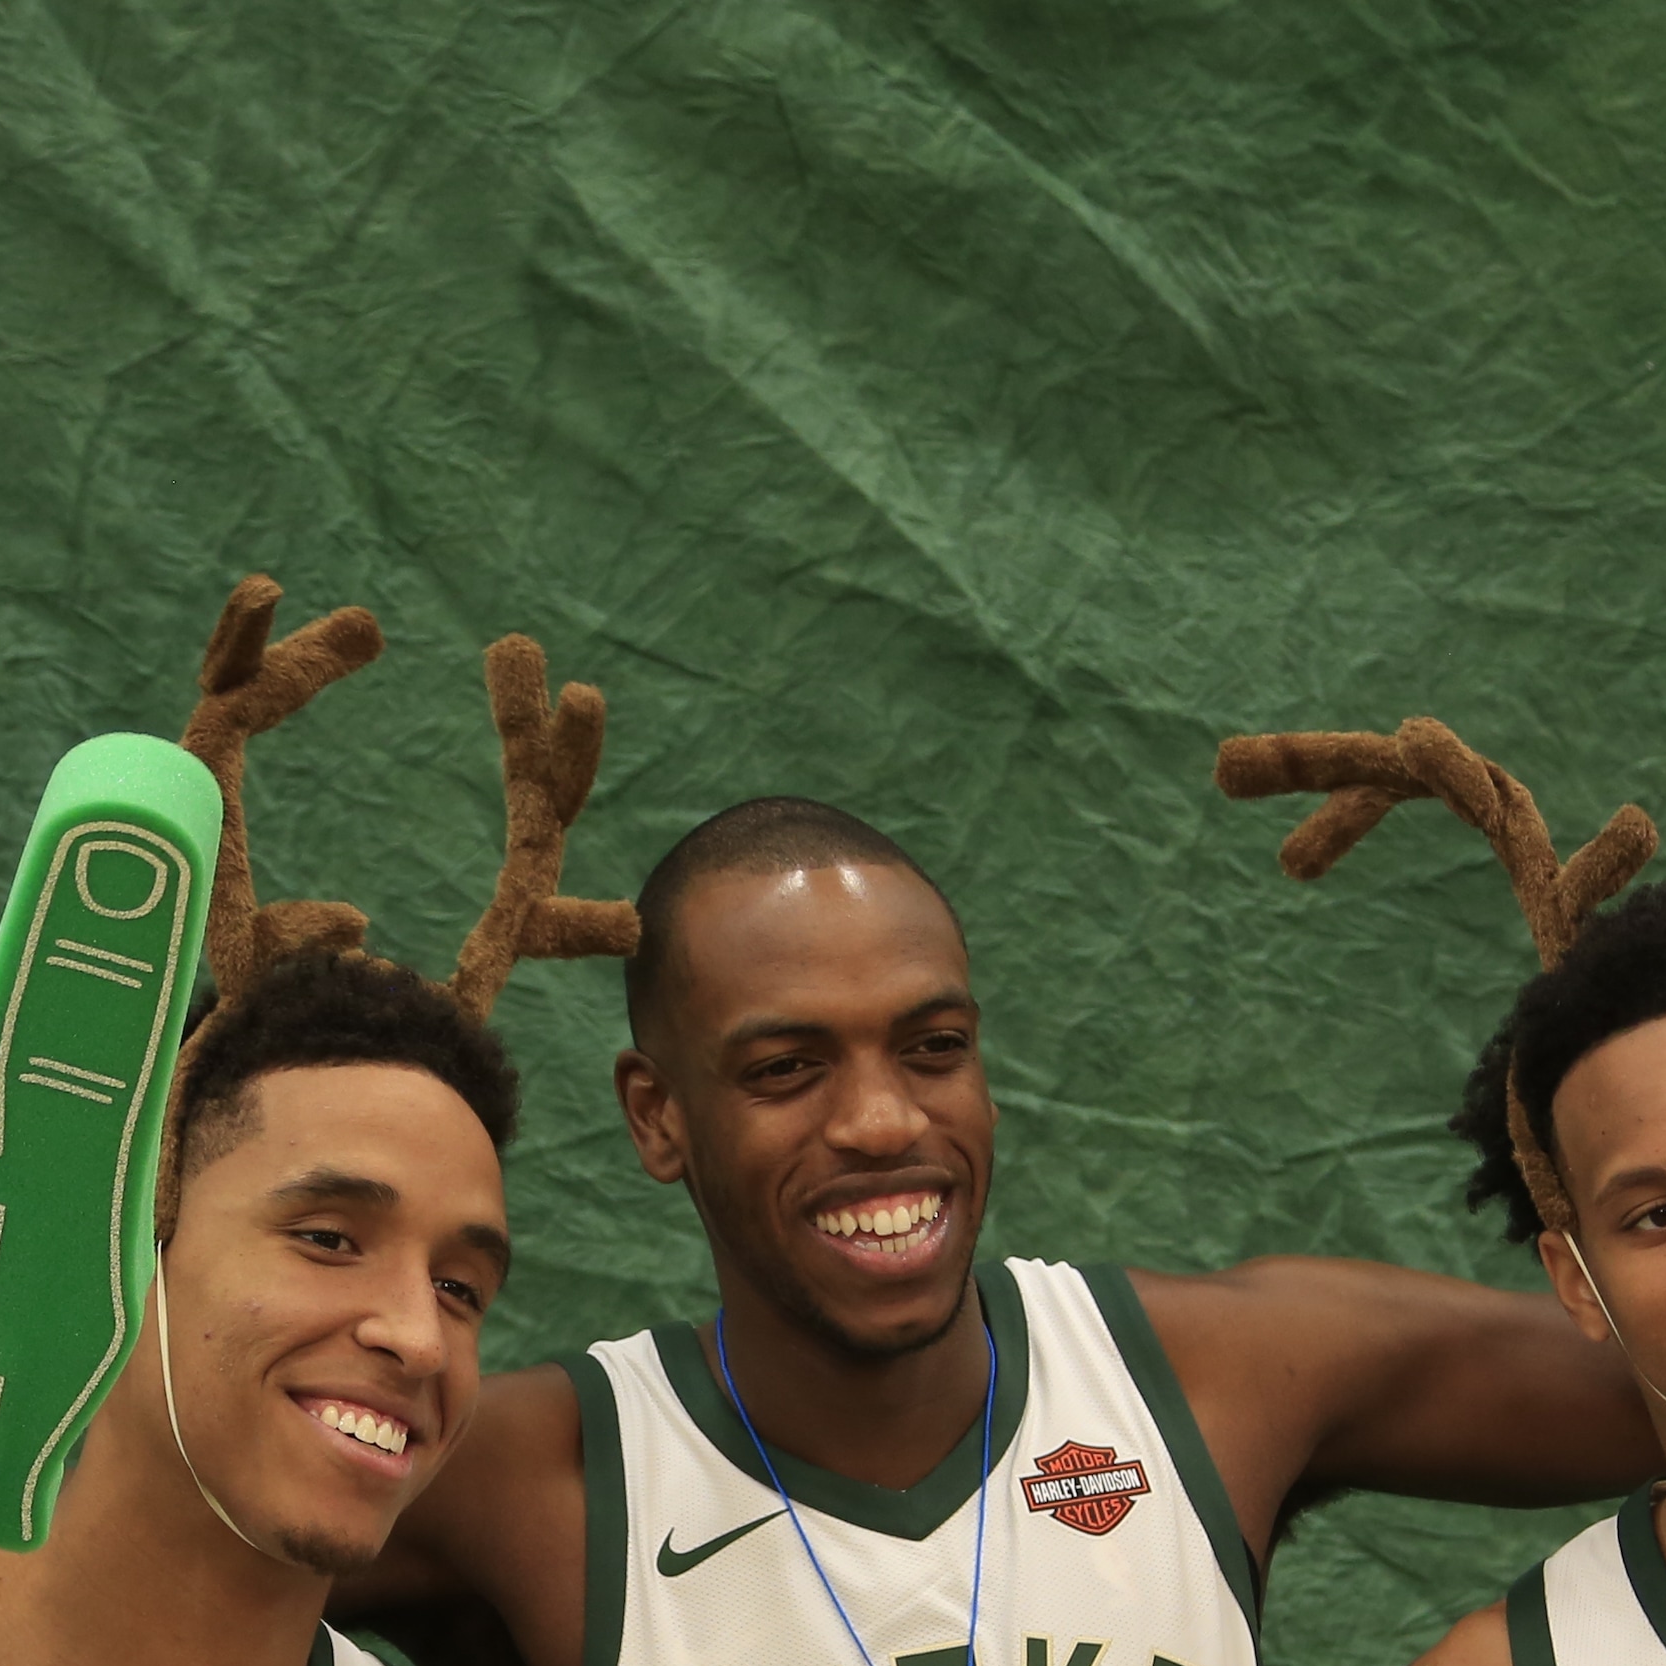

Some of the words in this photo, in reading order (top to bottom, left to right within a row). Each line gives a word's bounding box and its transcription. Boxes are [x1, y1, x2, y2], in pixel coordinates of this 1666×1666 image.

[1049, 1448, 1108, 1473] MOTOR
[1030, 1468, 1141, 1503] HARLEY-DAVIDSON
[1064, 1498, 1122, 1527] CYCLES
